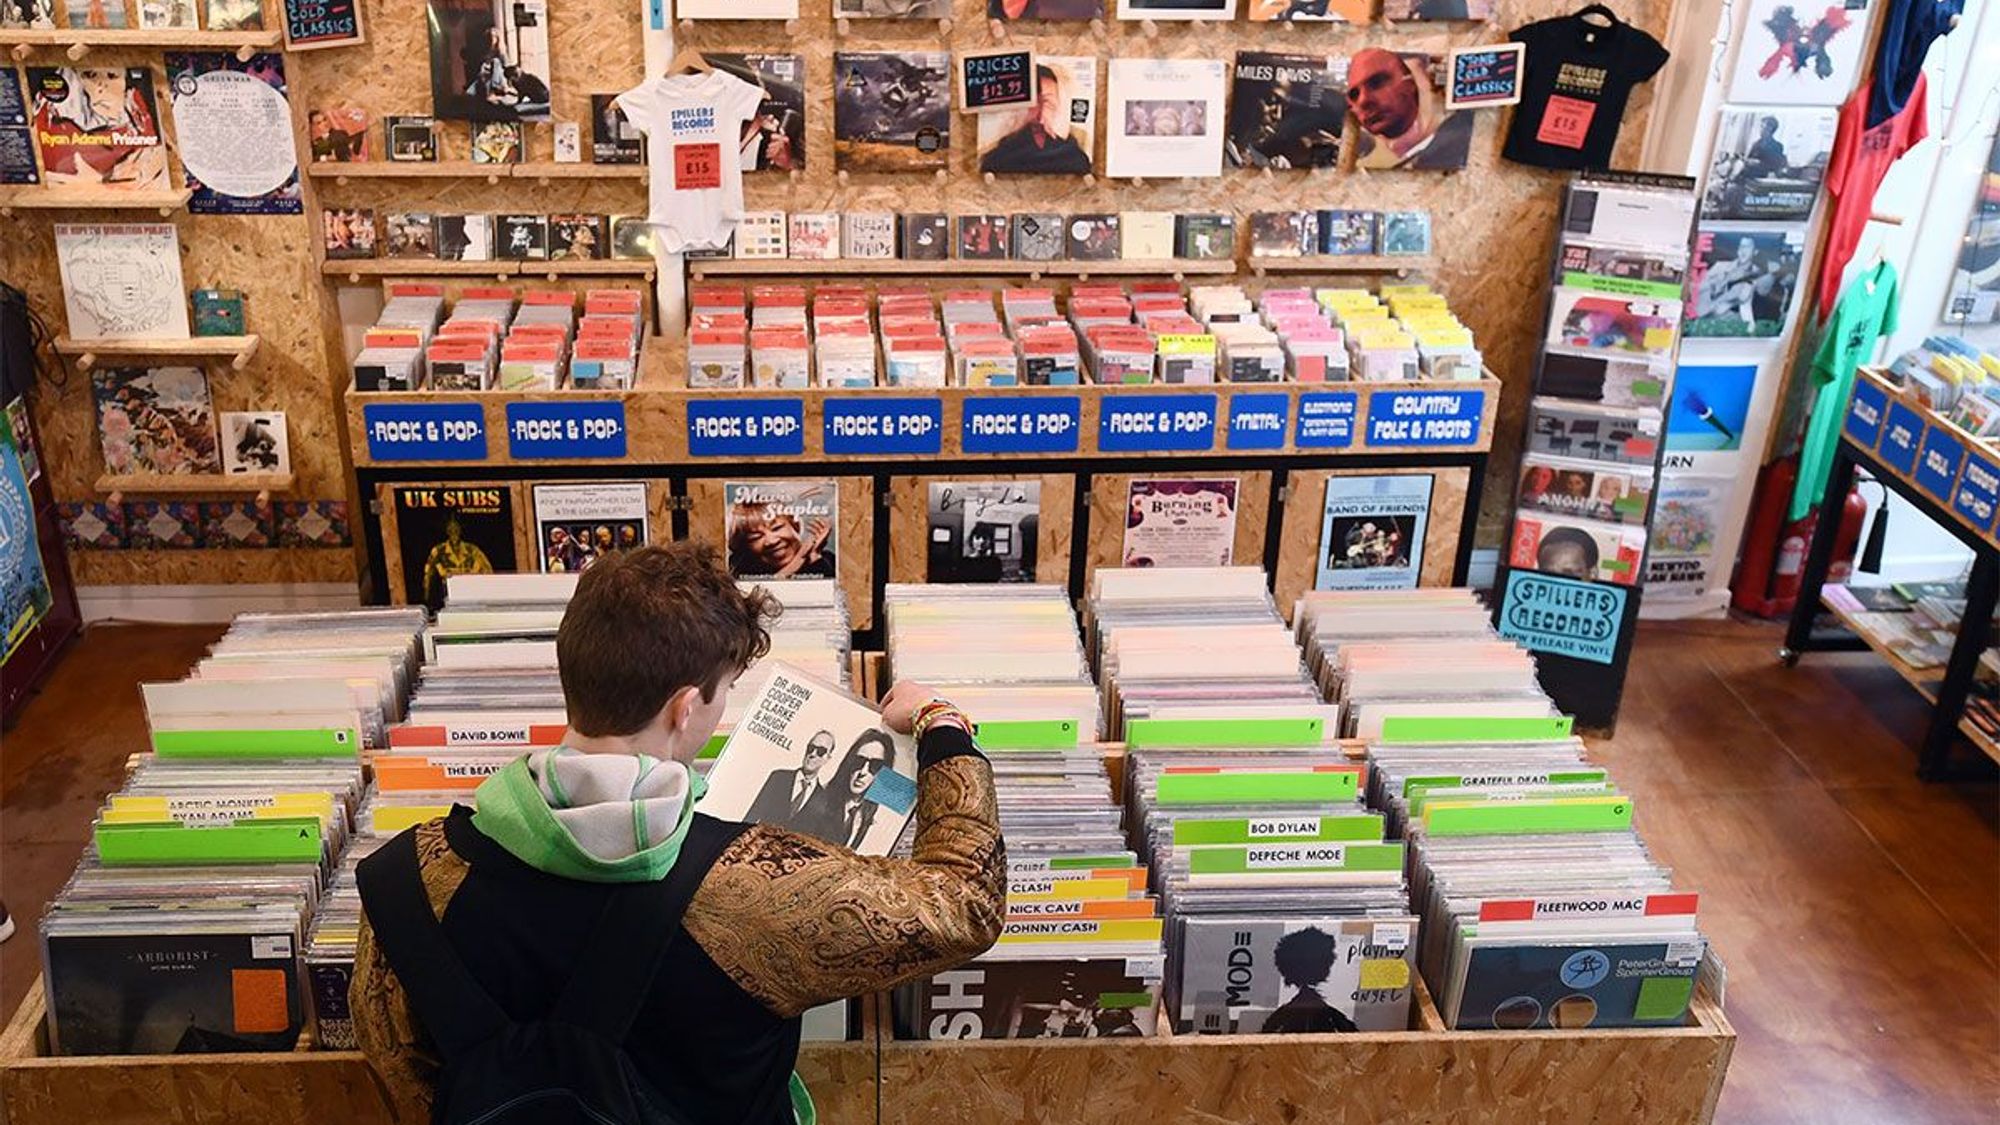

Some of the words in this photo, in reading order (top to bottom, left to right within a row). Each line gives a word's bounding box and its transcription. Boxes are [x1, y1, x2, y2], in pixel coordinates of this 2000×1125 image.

[289, 6, 326, 20] COLD
[291, 18, 353, 38] CLASSICS
[967, 56, 1021, 75] PRICES
[1236, 65, 1273, 81] MILES
[1275, 67, 1312, 83] DAVIS
[1454, 80, 1514, 97] CLASSICS
[671, 107, 714, 120] SPILLERS
[672, 118, 714, 130] RECORDS
[40, 131, 69, 147] Ryan
[72, 131, 111, 146] Adams
[112, 131, 158, 146] Prisoner
[686, 162, 710, 175] £15
[1392, 396, 1461, 415] COUNTRY
[516, 419, 562, 441] ROCK
[566, 419, 579, 440] &
[583, 418, 617, 440] POP
[695, 416, 741, 437] ROCK
[746, 416, 757, 437] &
[762, 415, 796, 437] POP
[833, 415, 877, 436] ROCK
[882, 415, 894, 436] &
[899, 415, 932, 436] POP
[972, 414, 1016, 435] ROCK
[1021, 414, 1033, 434] &
[1036, 414, 1070, 434] POP
[1110, 412, 1154, 433] ROCK
[1158, 412, 1171, 433] &
[1174, 411, 1209, 432] POP
[1235, 413, 1281, 430] METAL
[1374, 420, 1408, 440] FOLK
[1411, 420, 1423, 439] &
[1424, 420, 1472, 439] ROOTS
[375, 421, 422, 442] ROCK
[426, 421, 439, 441] &
[443, 421, 478, 441] POP
[404, 490, 437, 508] UK
[443, 490, 501, 507] SUBS
[734, 486, 793, 504] Mavis
[762, 500, 829, 522] Staples
[1327, 506, 1359, 514] BAND
[1361, 505, 1376, 514] OF
[1380, 504, 1426, 513] FRIENDS
[1521, 582, 1611, 612] SPILLERS
[1517, 607, 1606, 637] RECORDS
[1531, 634, 1575, 650] RELEASE
[1579, 643, 1611, 657] VINYL
[774, 676, 788, 689] DR
[787, 682, 813, 700] JOHN
[766, 687, 804, 711] COOPER
[760, 698, 796, 722] CLARKE
[753, 710, 761, 721] &
[760, 712, 788, 732] HUGH
[1555, 720, 1564, 729] H
[337, 732, 345, 742] B
[452, 731, 487, 741] DAVID
[490, 730, 526, 740] BOWIE
[746, 720, 794, 751] CORNWELL
[447, 766, 467, 775] THE
[470, 766, 499, 775] BEAT
[1462, 776, 1513, 787] GRATEFUL
[1517, 775, 1548, 785] DEAD
[170, 800, 212, 810] ARCTIC
[216, 798, 274, 808] MONKEYS
[1614, 805, 1624, 815] G
[299, 829, 309, 838] A
[1251, 823, 1275, 834] BOB
[1278, 822, 1317, 834] DYLAN
[1249, 850, 1300, 862] DEPECHE
[1306, 849, 1341, 860] MODE
[1011, 883, 1052, 893] CLASH
[1009, 904, 1043, 914] NICK
[1045, 903, 1081, 913] CAVE
[1537, 901, 1608, 914] FLEETWOOD
[1612, 899, 1643, 911] MAC
[1003, 923, 1058, 934] JOHNNY
[1062, 922, 1098, 933] CASH
[137, 950, 209, 962] ARBORIST
[1226, 932, 1253, 1007] MODE
[1614, 967, 1695, 978] SplinterGroup
